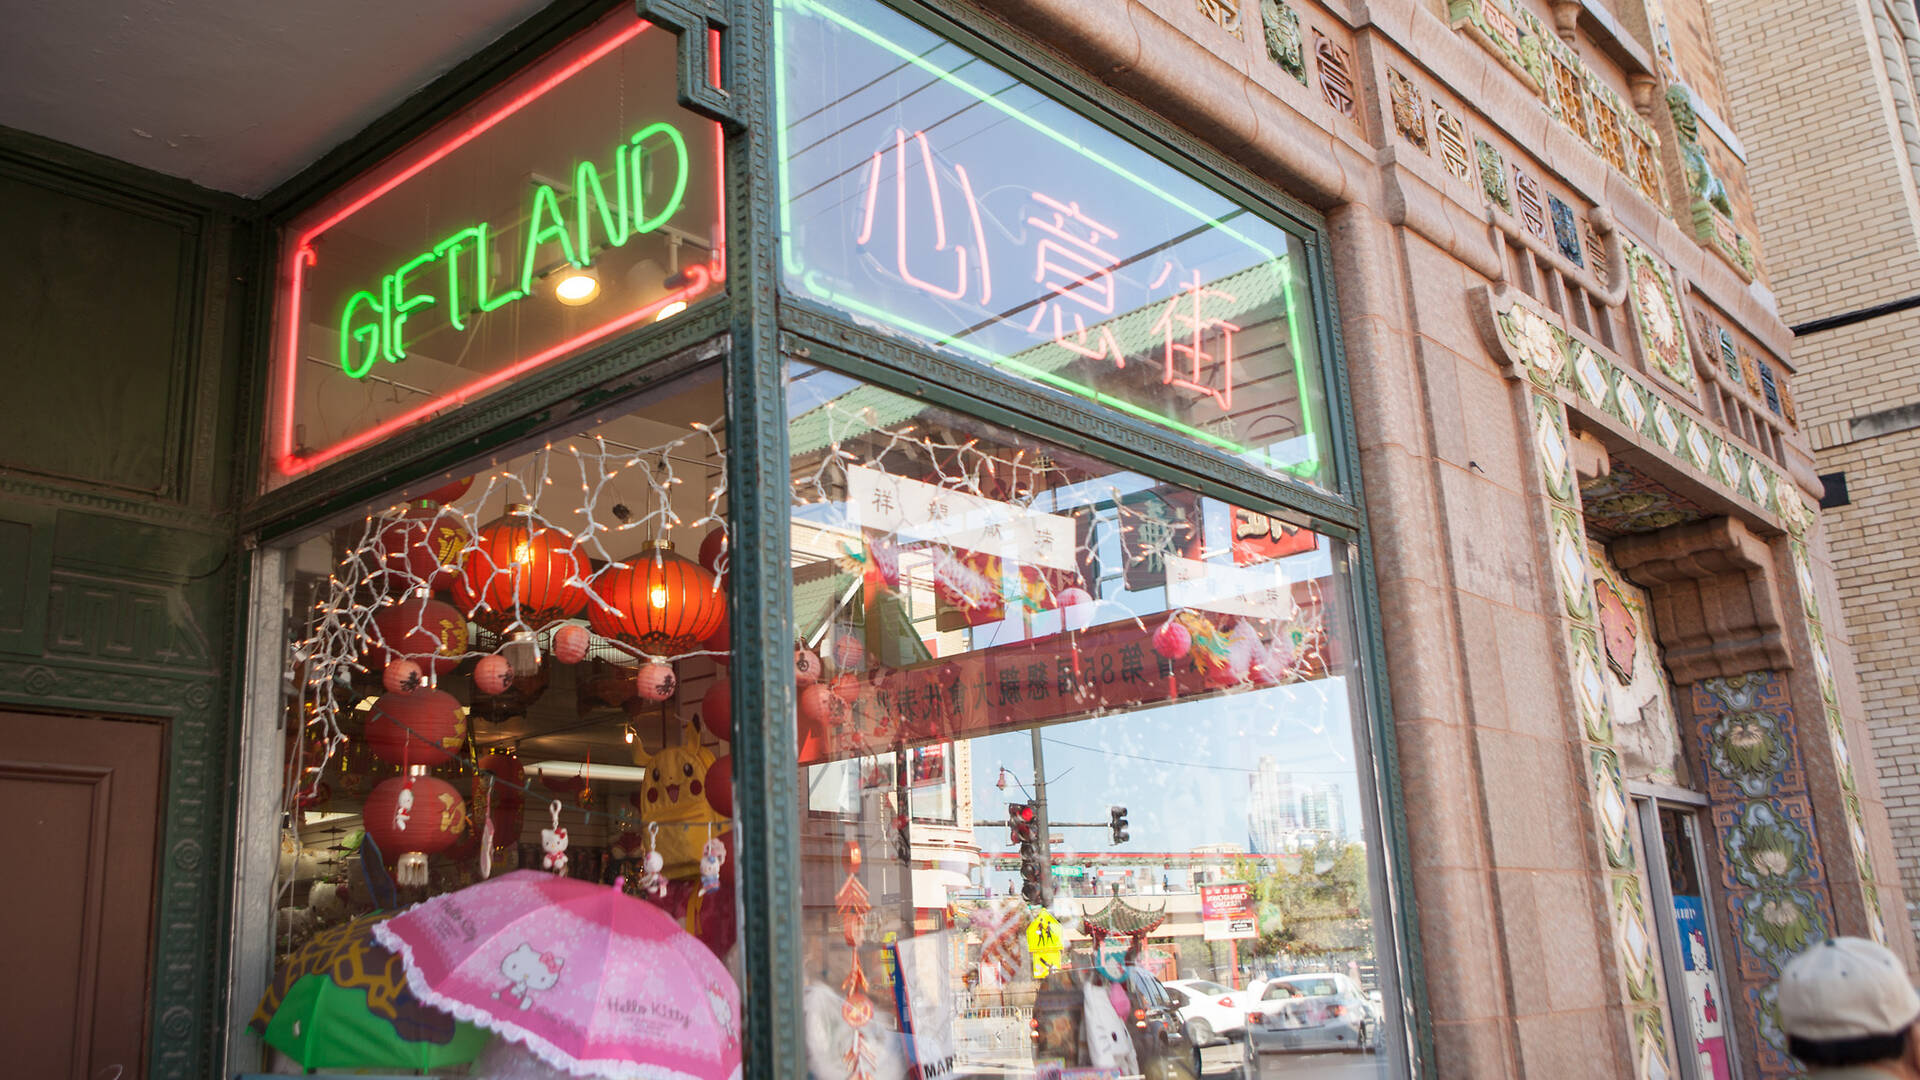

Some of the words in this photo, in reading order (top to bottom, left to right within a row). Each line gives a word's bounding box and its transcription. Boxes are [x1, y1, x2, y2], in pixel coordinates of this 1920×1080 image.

[340, 121, 690, 380] GIFTLAND
[857, 128, 1241, 412] 心意街
[606, 998, 647, 1015] Hello
[650, 1001, 692, 1029] Kitty
